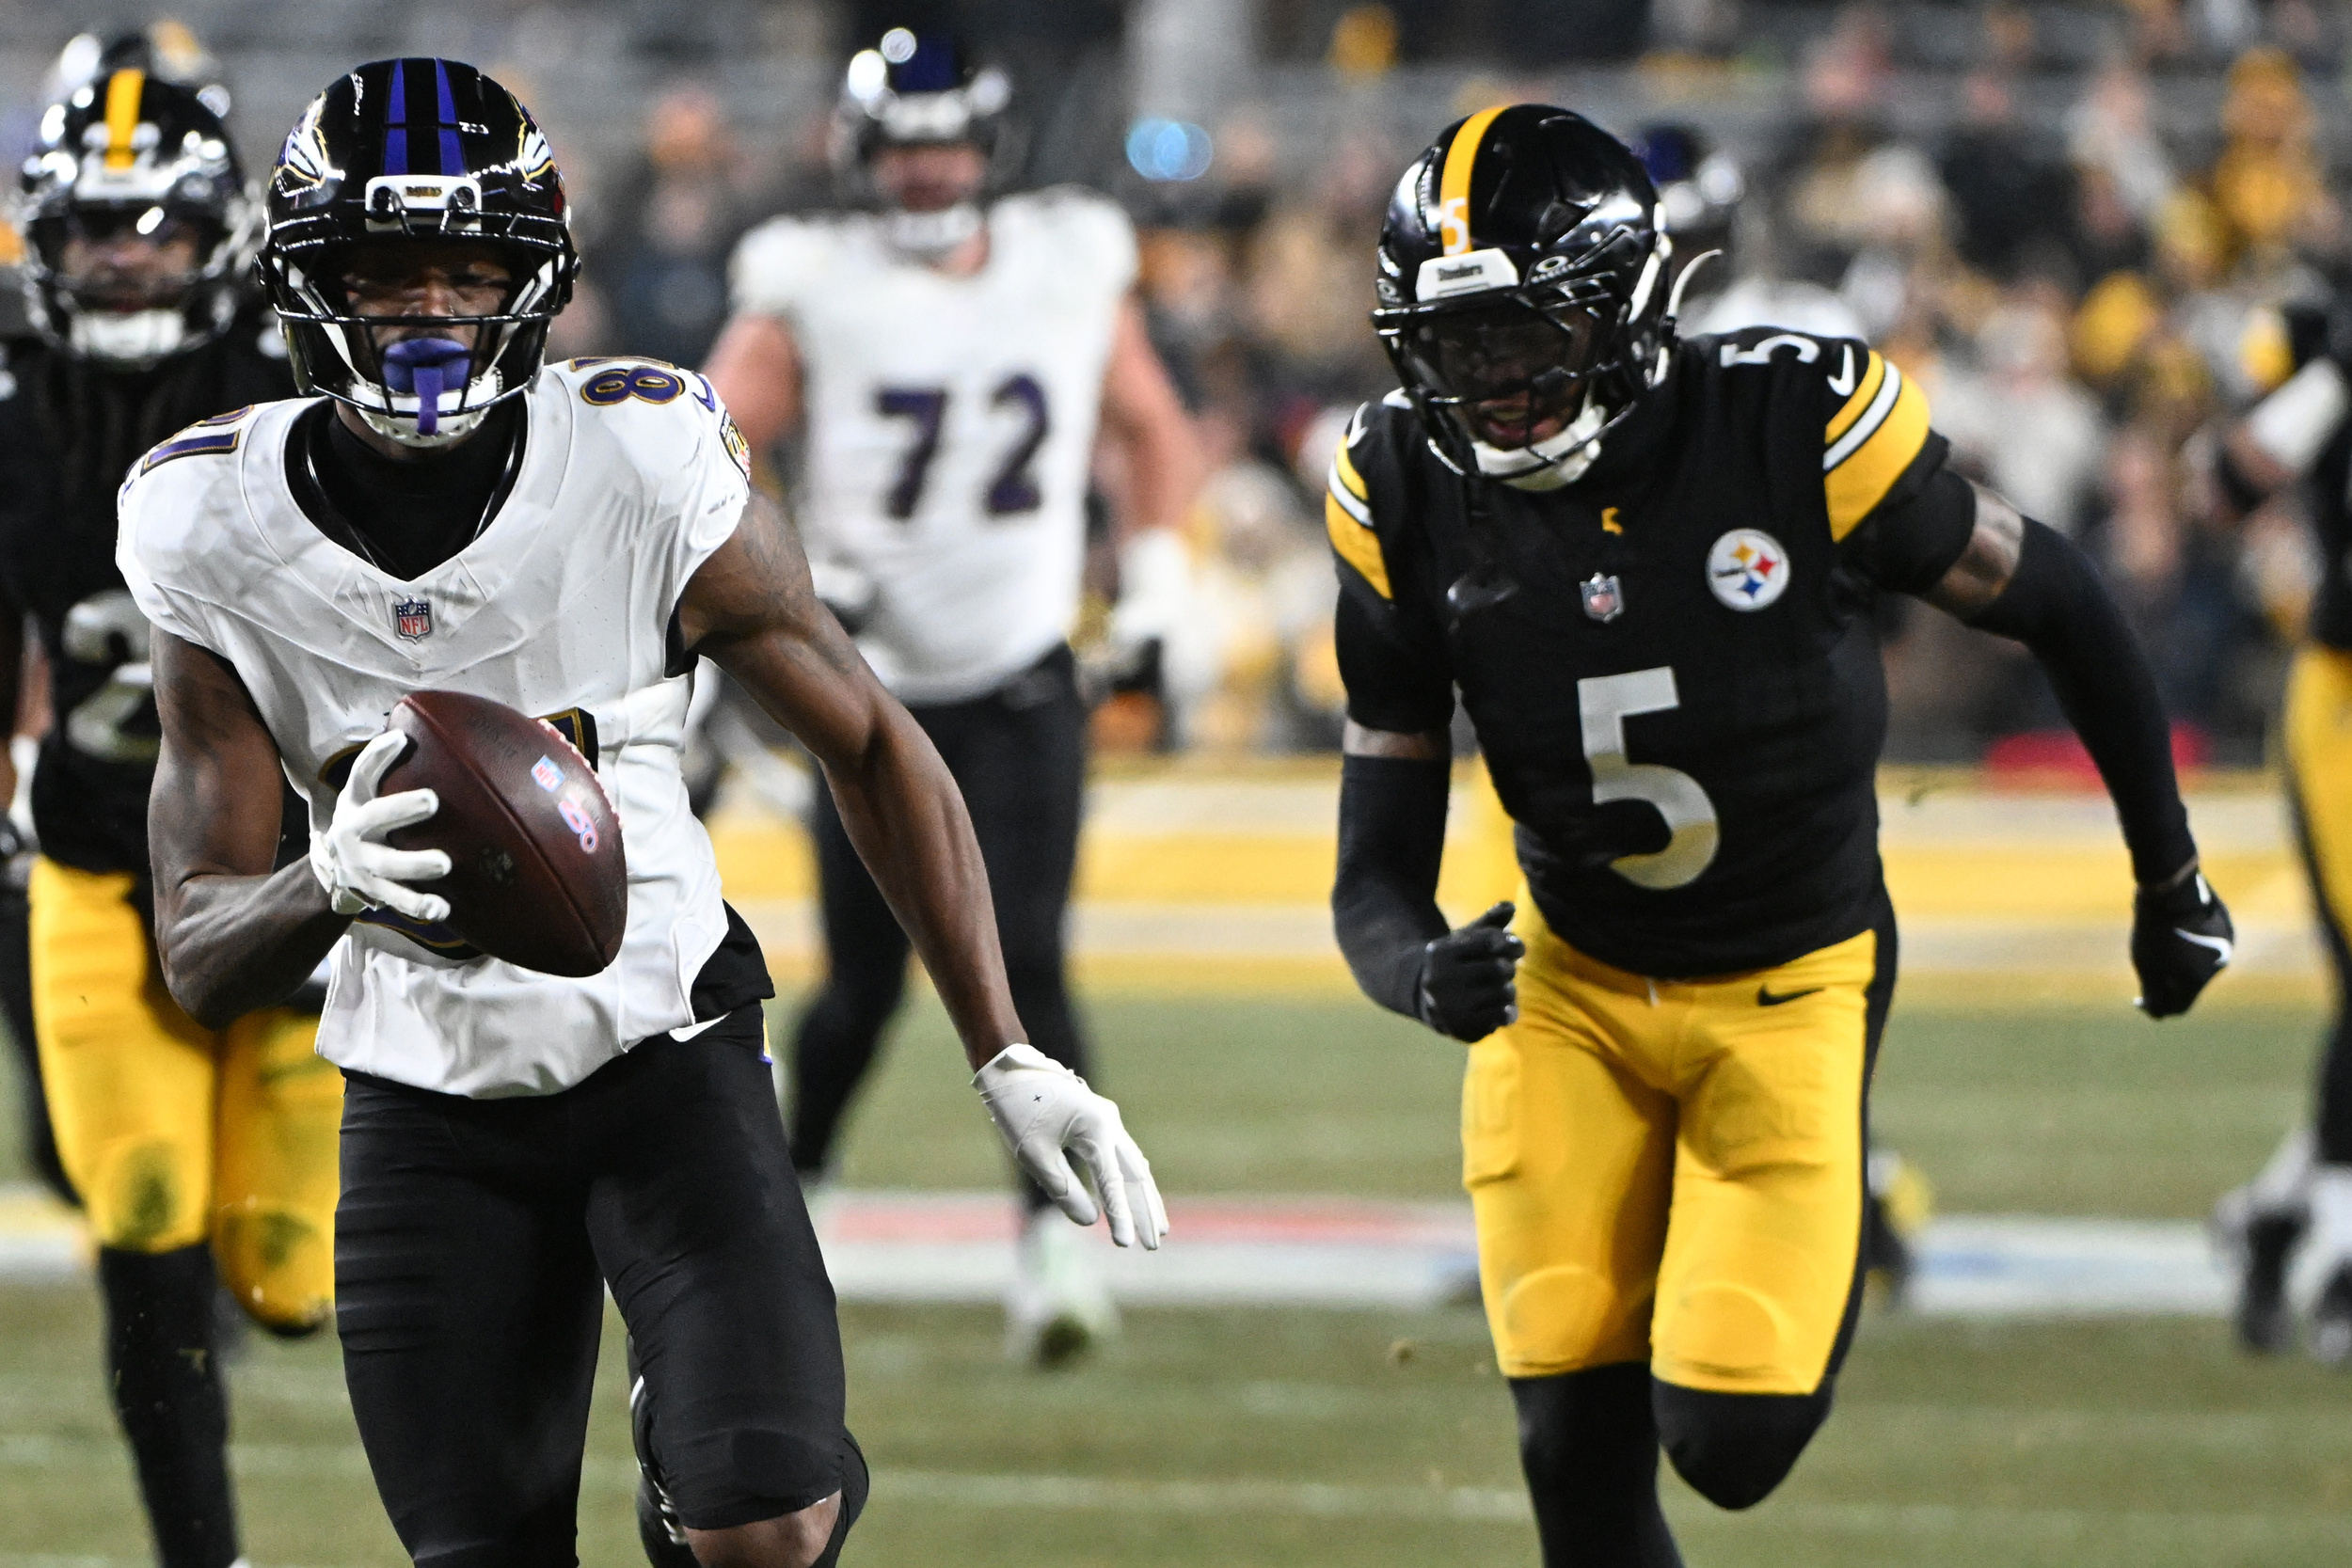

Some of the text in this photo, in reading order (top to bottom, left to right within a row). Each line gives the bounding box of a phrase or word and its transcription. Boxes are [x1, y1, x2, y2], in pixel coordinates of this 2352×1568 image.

[1443, 197, 1469, 257] 5
[1720, 334, 1820, 369] 5
[877, 371, 1050, 519] 72
[400, 614, 429, 636] NFL
[534, 764, 558, 789] NFL
[1577, 665, 1721, 890] 5
